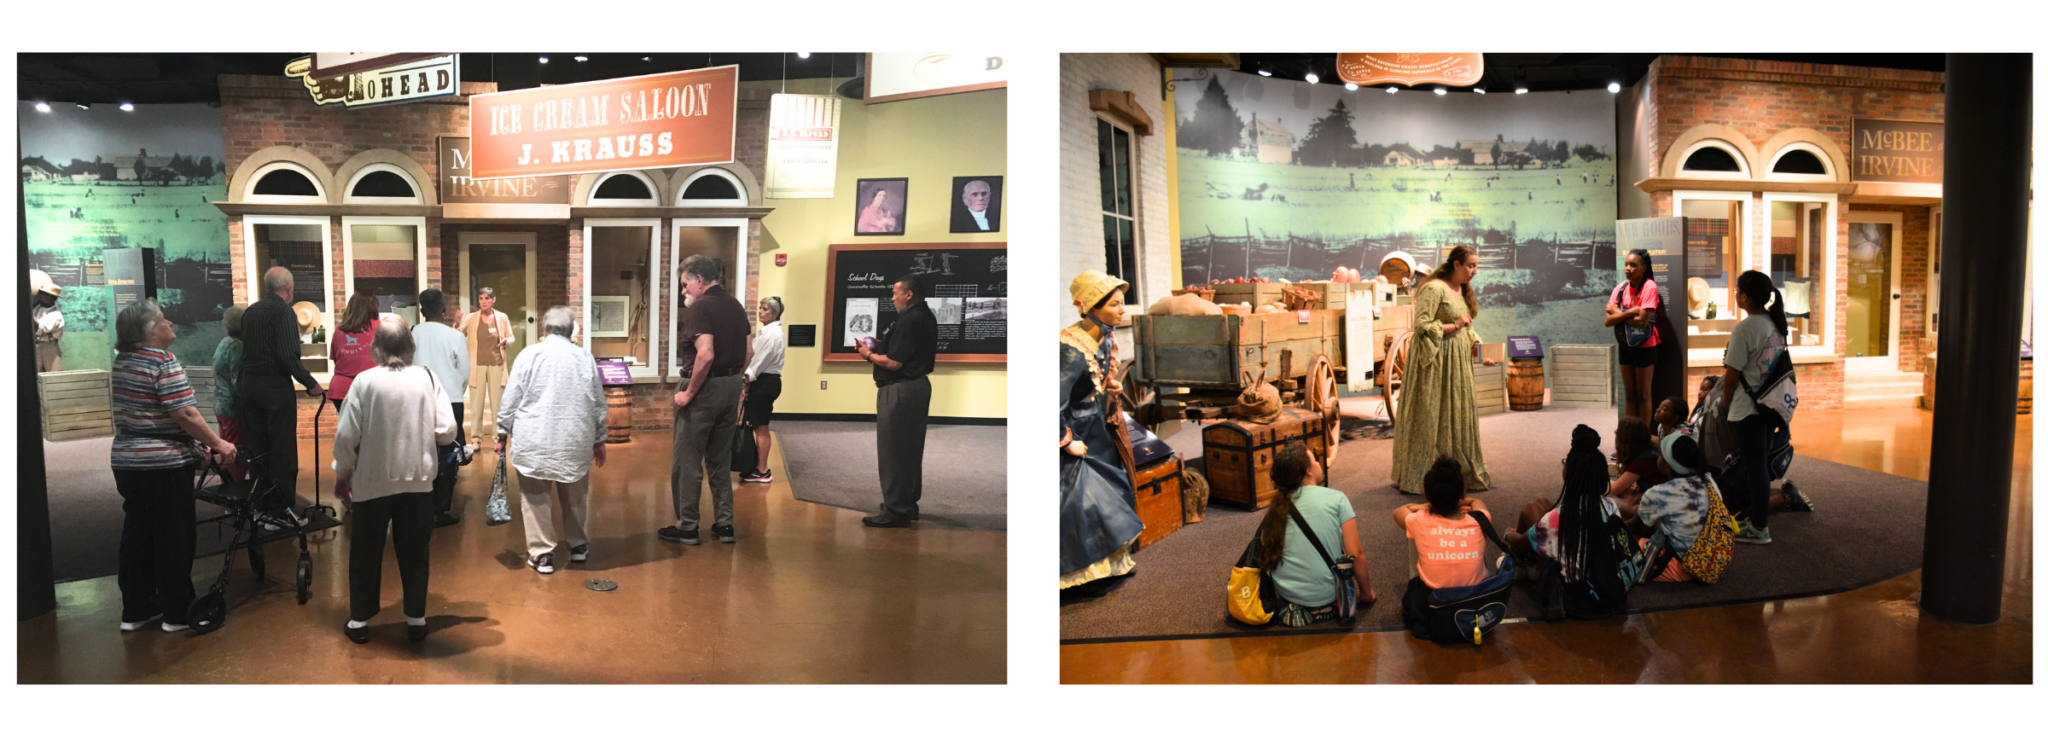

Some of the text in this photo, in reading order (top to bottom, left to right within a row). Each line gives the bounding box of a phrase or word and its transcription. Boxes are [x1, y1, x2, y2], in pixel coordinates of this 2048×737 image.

[490, 83, 712, 136] ICE CREAM SALOON
[518, 132, 673, 166] J. KRAUSS
[1860, 155, 1935, 177] IRVINE
[451, 175, 538, 197] IRVINE
[847, 272, 869, 282] School
[1430, 526, 1475, 537] always
[1439, 538, 1455, 547] be
[1428, 551, 1479, 560] unicorn
